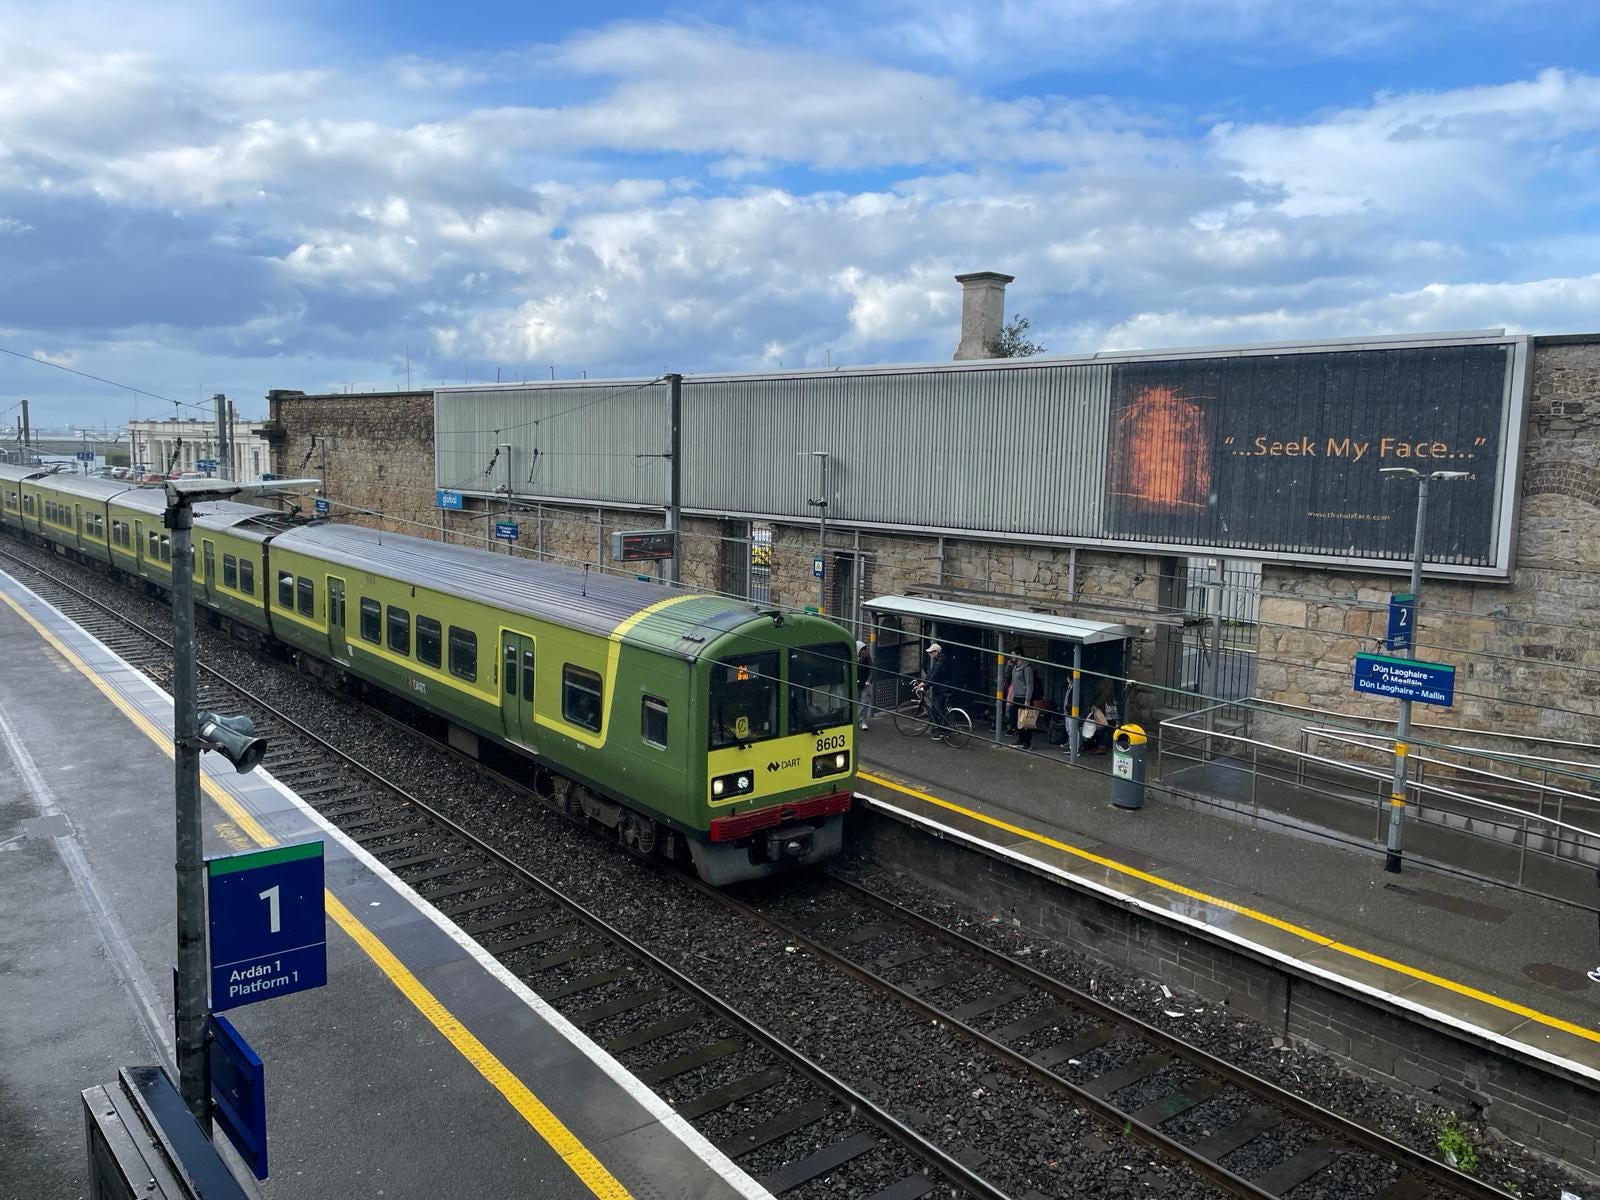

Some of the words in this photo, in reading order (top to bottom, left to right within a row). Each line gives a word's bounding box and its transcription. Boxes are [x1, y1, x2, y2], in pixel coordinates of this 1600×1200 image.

[1326, 437, 1370, 463] My
[1399, 607, 1408, 627] 2
[1390, 666, 1427, 679] Laoghaire
[1376, 682, 1414, 696] Laoghaire
[1420, 689, 1445, 701] Mallin
[816, 735, 846, 752] 8603
[781, 758, 801, 770] DART
[258, 884, 281, 933] 1
[229, 965, 271, 983] Ardán
[274, 960, 281, 972] 1
[229, 973, 289, 998] Platform
[292, 970, 299, 983] 1
